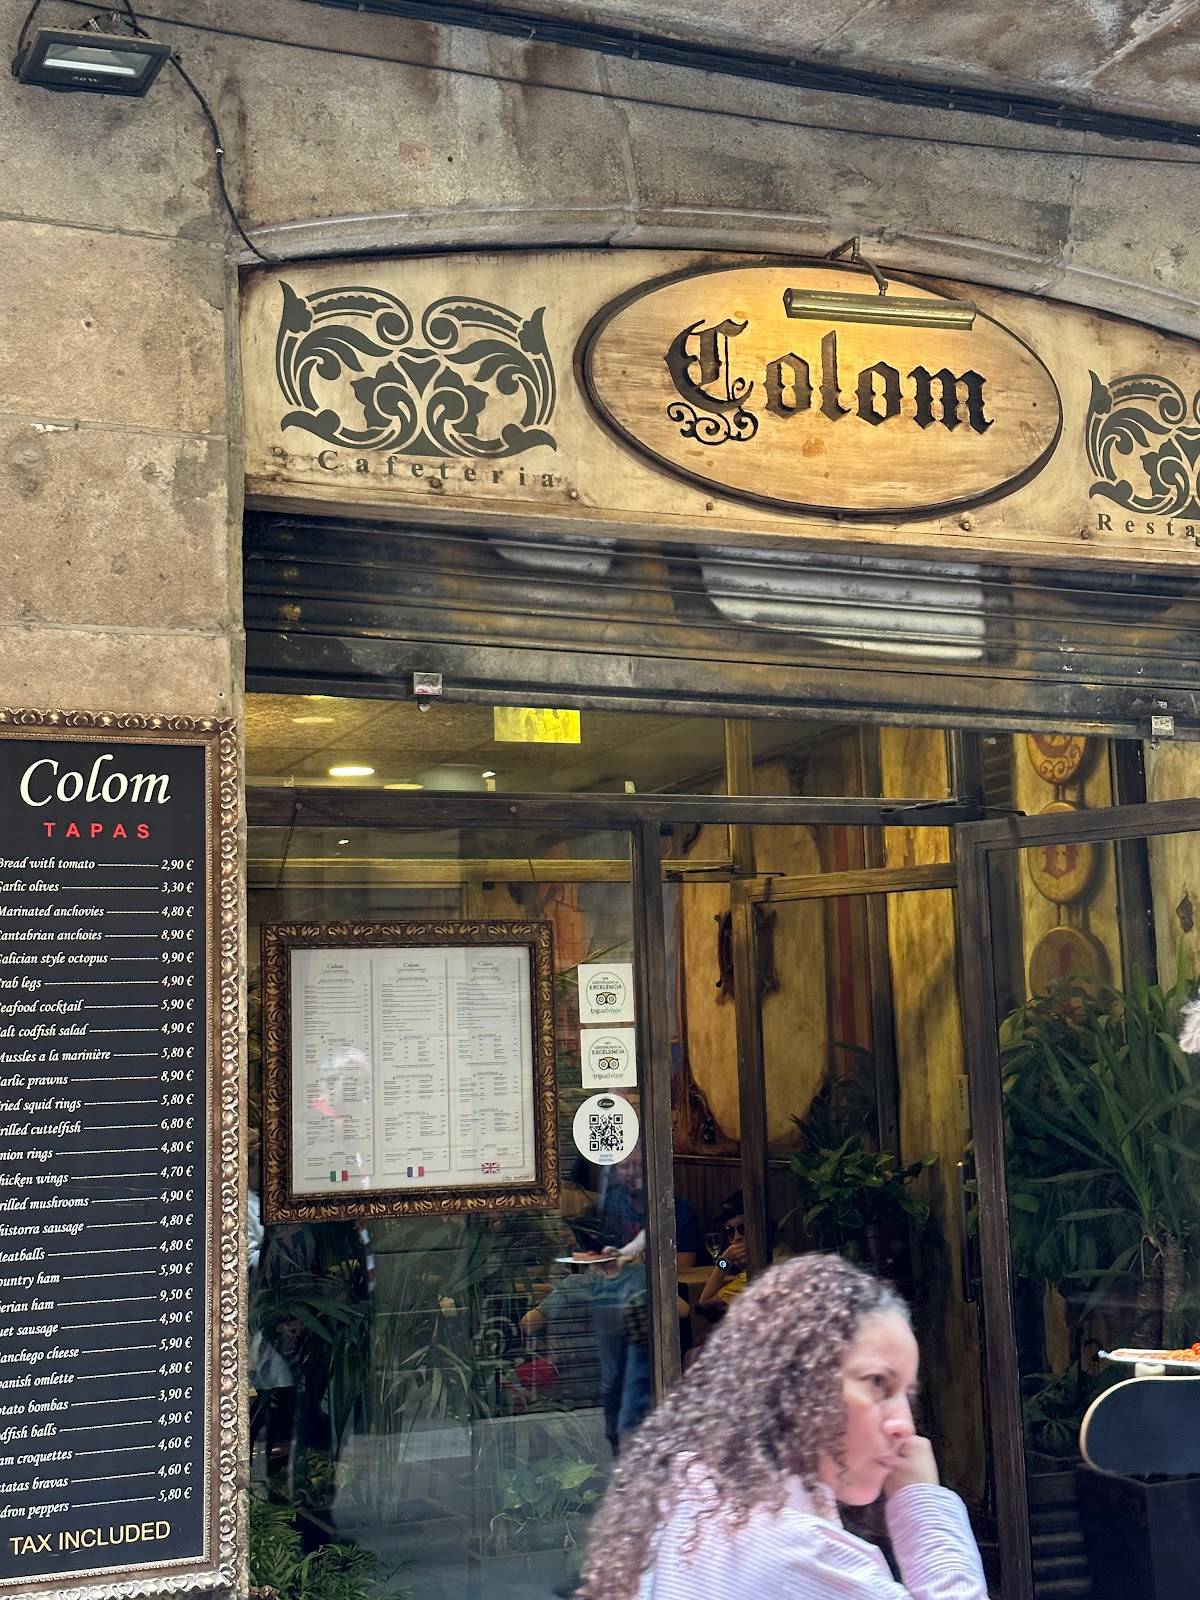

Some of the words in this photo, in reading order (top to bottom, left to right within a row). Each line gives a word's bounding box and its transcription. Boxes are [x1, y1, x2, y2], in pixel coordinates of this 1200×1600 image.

[663, 318, 994, 436] Colom
[317, 450, 554, 488] Cafeteria
[19, 754, 171, 807] Colom
[43, 822, 150, 839] TAPAS
[29, 857, 55, 868] with
[58, 860, 95, 868] tomato
[161, 860, 184, 871] 2,90
[187, 860, 194, 870] €
[29, 880, 59, 891] olives
[162, 882, 184, 893] 3,30
[187, 882, 194, 893] €
[54, 905, 104, 916] anchovies
[162, 906, 184, 918] 4,80
[187, 906, 194, 917] €
[0, 929, 54, 940] antabrian
[57, 928, 102, 940] anchoies
[161, 930, 184, 941] 8,90
[187, 930, 194, 940] €
[0, 952, 38, 964] alician
[40, 952, 65, 967] style
[68, 954, 108, 966] octopus
[162, 952, 184, 964] 9,90
[187, 952, 194, 963] €
[0, 976, 18, 988] rab
[21, 976, 41, 991] legs
[161, 976, 184, 987] 4,90
[187, 976, 194, 986] €
[0, 1000, 39, 1016] eafood
[40, 999, 84, 1014] cocktail
[161, 999, 184, 1011] 5,90
[187, 999, 194, 1009] €
[0, 1025, 15, 1037] alt
[19, 1024, 56, 1040] codfish
[58, 1023, 89, 1036] salad
[161, 1023, 184, 1035] 4,90
[187, 1023, 194, 1033] €
[49, 1049, 59, 1061] la
[62, 1049, 111, 1060] marinière
[161, 1047, 184, 1059] 5,80
[186, 1047, 194, 1057] €
[0, 1074, 25, 1086] arlic
[26, 1077, 68, 1089] prawns
[161, 1070, 184, 1082] 8,90
[186, 1070, 194, 1081] €
[0, 1098, 23, 1111] ried
[23, 1097, 55, 1113] squid
[55, 1098, 82, 1112] rings
[161, 1094, 184, 1106] 5,80
[186, 1094, 194, 1104] €
[31, 1121, 81, 1137] cuttelfish
[161, 1118, 184, 1130] 6,80
[186, 1118, 194, 1128] €
[27, 1148, 53, 1162] rings
[161, 1141, 183, 1154] 4,80
[186, 1141, 194, 1152] €
[36, 1172, 68, 1186] wings
[160, 1166, 183, 1179] 4,70
[186, 1165, 193, 1176] €
[30, 1196, 89, 1209] mushrooms
[160, 1190, 183, 1203] 4,90
[186, 1190, 193, 1201] €
[42, 1223, 84, 1235] sausage
[160, 1215, 183, 1228] 4,80
[186, 1214, 193, 1225] €
[0, 1247, 45, 1262] eatballs
[160, 1240, 183, 1253] 4,80
[186, 1239, 193, 1250] €
[37, 1272, 60, 1284] ham
[159, 1264, 182, 1276] 5,90
[185, 1263, 193, 1274] €
[31, 1298, 54, 1310] ham
[160, 1289, 183, 1302] 9,50
[185, 1288, 193, 1299] €
[16, 1324, 58, 1337] sausage
[159, 1312, 182, 1325] 4,90
[185, 1311, 193, 1322] €
[0, 1349, 44, 1364] anchego
[47, 1346, 79, 1359] cheese
[159, 1337, 182, 1350] 5,90
[185, 1336, 192, 1348] €
[34, 1372, 74, 1386] omlette
[159, 1362, 182, 1375] 4,80
[185, 1361, 192, 1373] €
[28, 1398, 69, 1413] bombas
[158, 1388, 182, 1401] 3,90
[185, 1387, 192, 1399] €
[31, 1423, 57, 1437] balls
[158, 1412, 182, 1425] 4,90
[184, 1411, 192, 1423] €
[17, 1451, 73, 1466] croquettes
[158, 1437, 181, 1450] 4,60
[184, 1436, 192, 1448] €
[32, 1477, 68, 1490] bravas
[158, 1464, 181, 1476] 4,60
[184, 1462, 192, 1474] €
[27, 1503, 69, 1519] peppers
[158, 1488, 181, 1502] 5,80
[184, 1487, 192, 1499] €
[10, 1534, 52, 1556] TAX
[58, 1521, 171, 1550] INCLUDED
